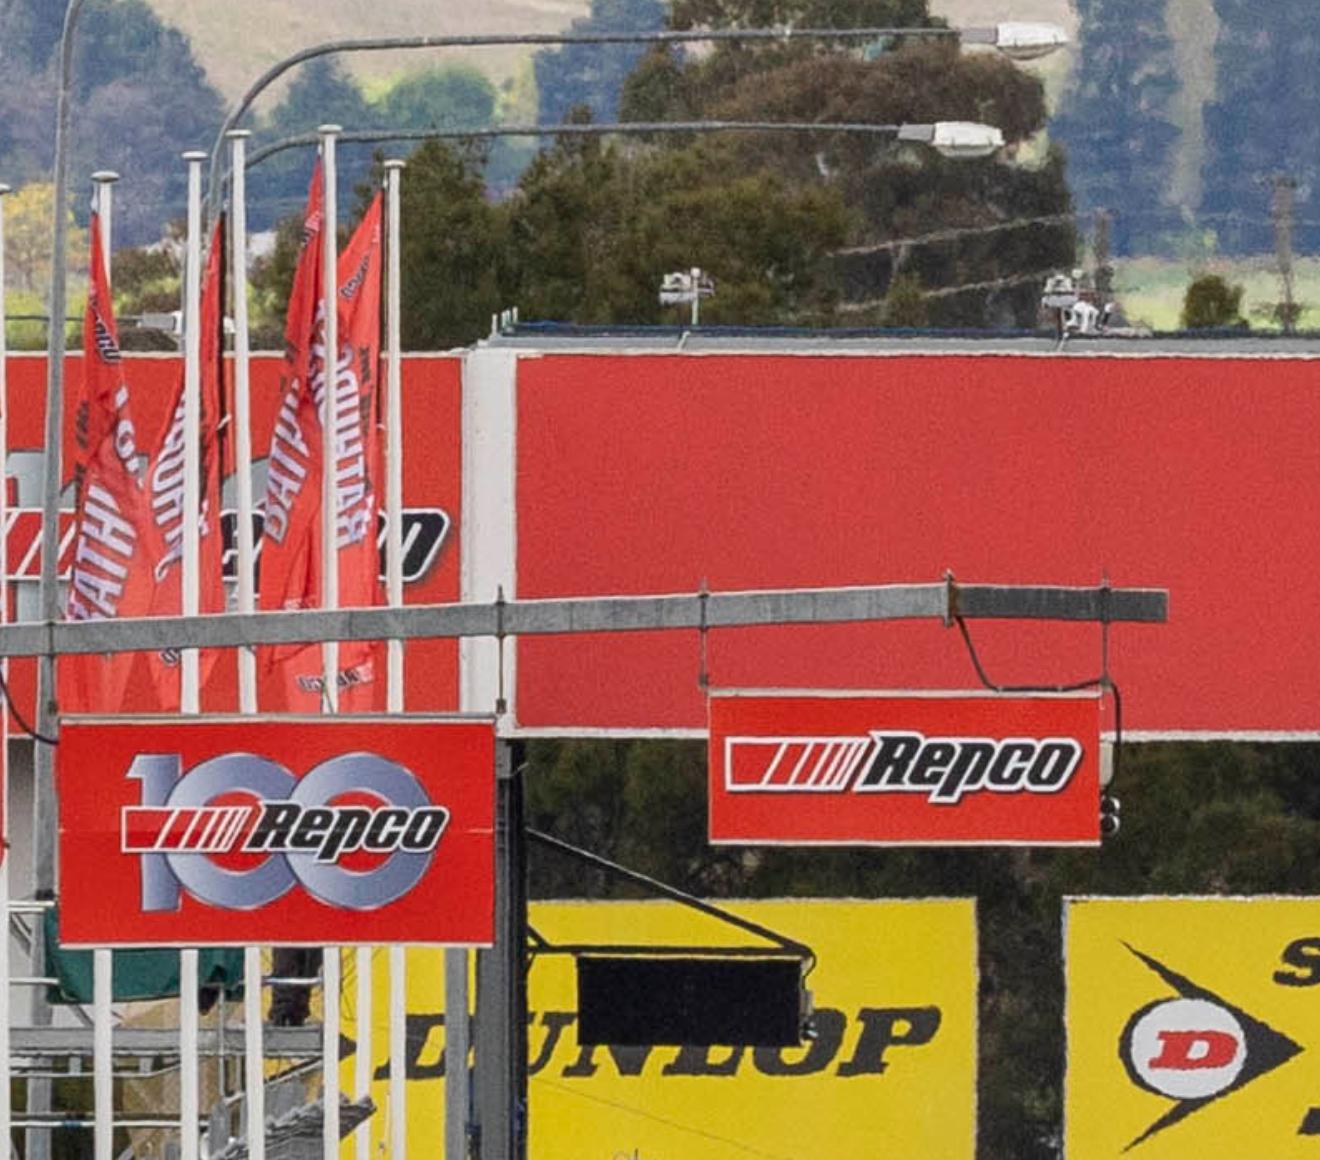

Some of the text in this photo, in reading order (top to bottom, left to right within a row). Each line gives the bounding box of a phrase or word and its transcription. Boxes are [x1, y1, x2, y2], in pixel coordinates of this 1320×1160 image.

[854, 731, 1085, 804] Repco
[126, 752, 434, 912] 100
[241, 802, 451, 865] Repco
[1148, 1030, 1240, 1070] D
